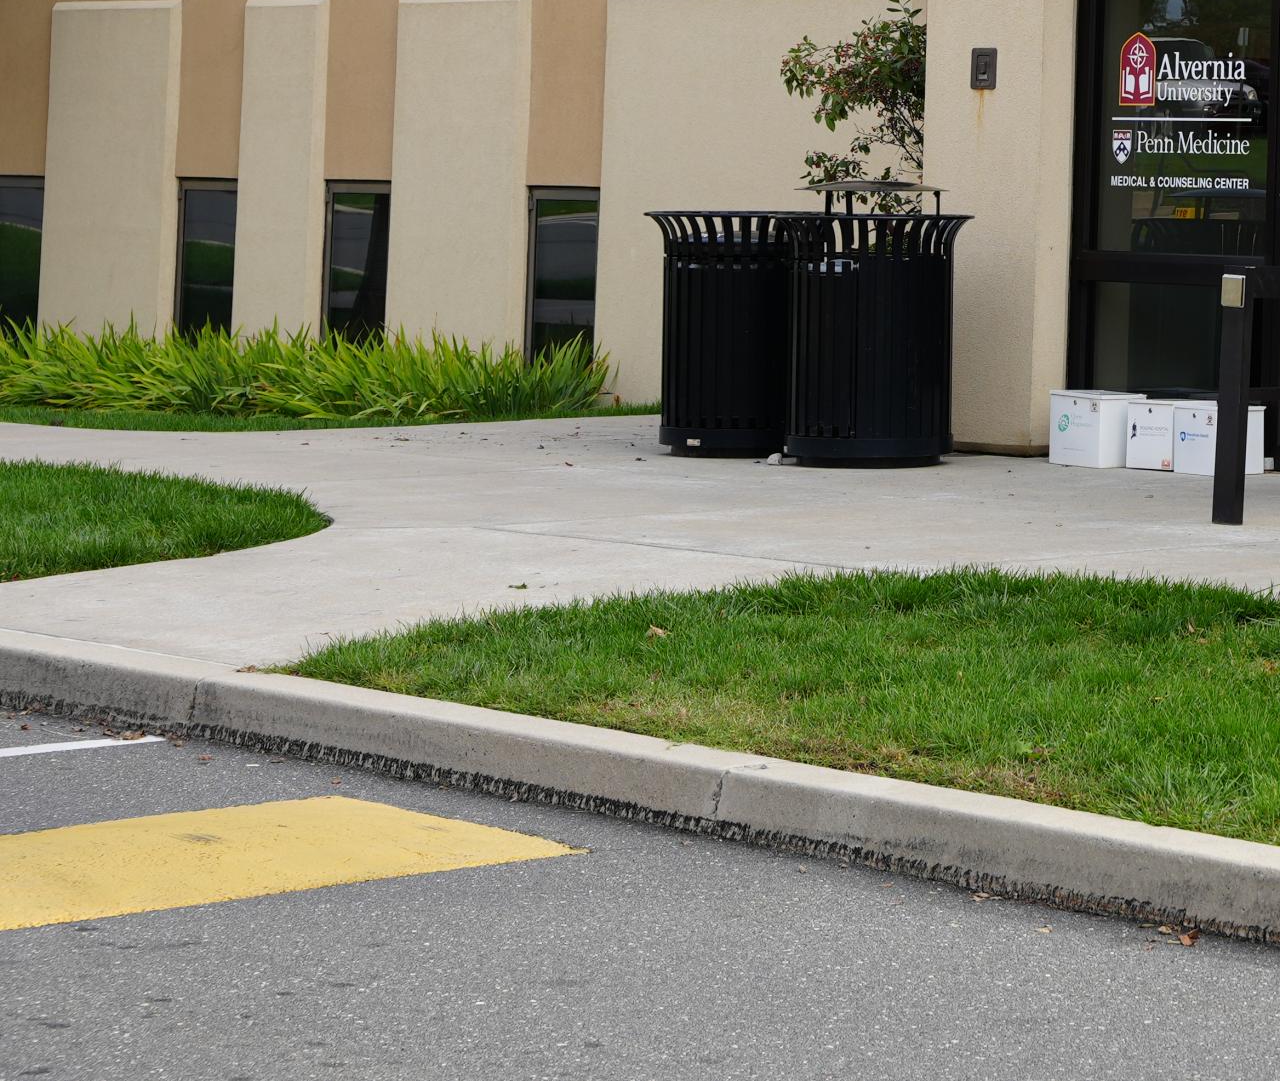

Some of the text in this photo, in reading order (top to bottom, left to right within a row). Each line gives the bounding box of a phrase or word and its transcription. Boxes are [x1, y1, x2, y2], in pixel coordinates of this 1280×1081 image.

[1157, 52, 1246, 80] Alvernia
[1157, 82, 1233, 107] University
[1136, 130, 1250, 155] Penn Medicine
[1111, 175, 1249, 189] MEDICAL & COUNSELING CENTER
